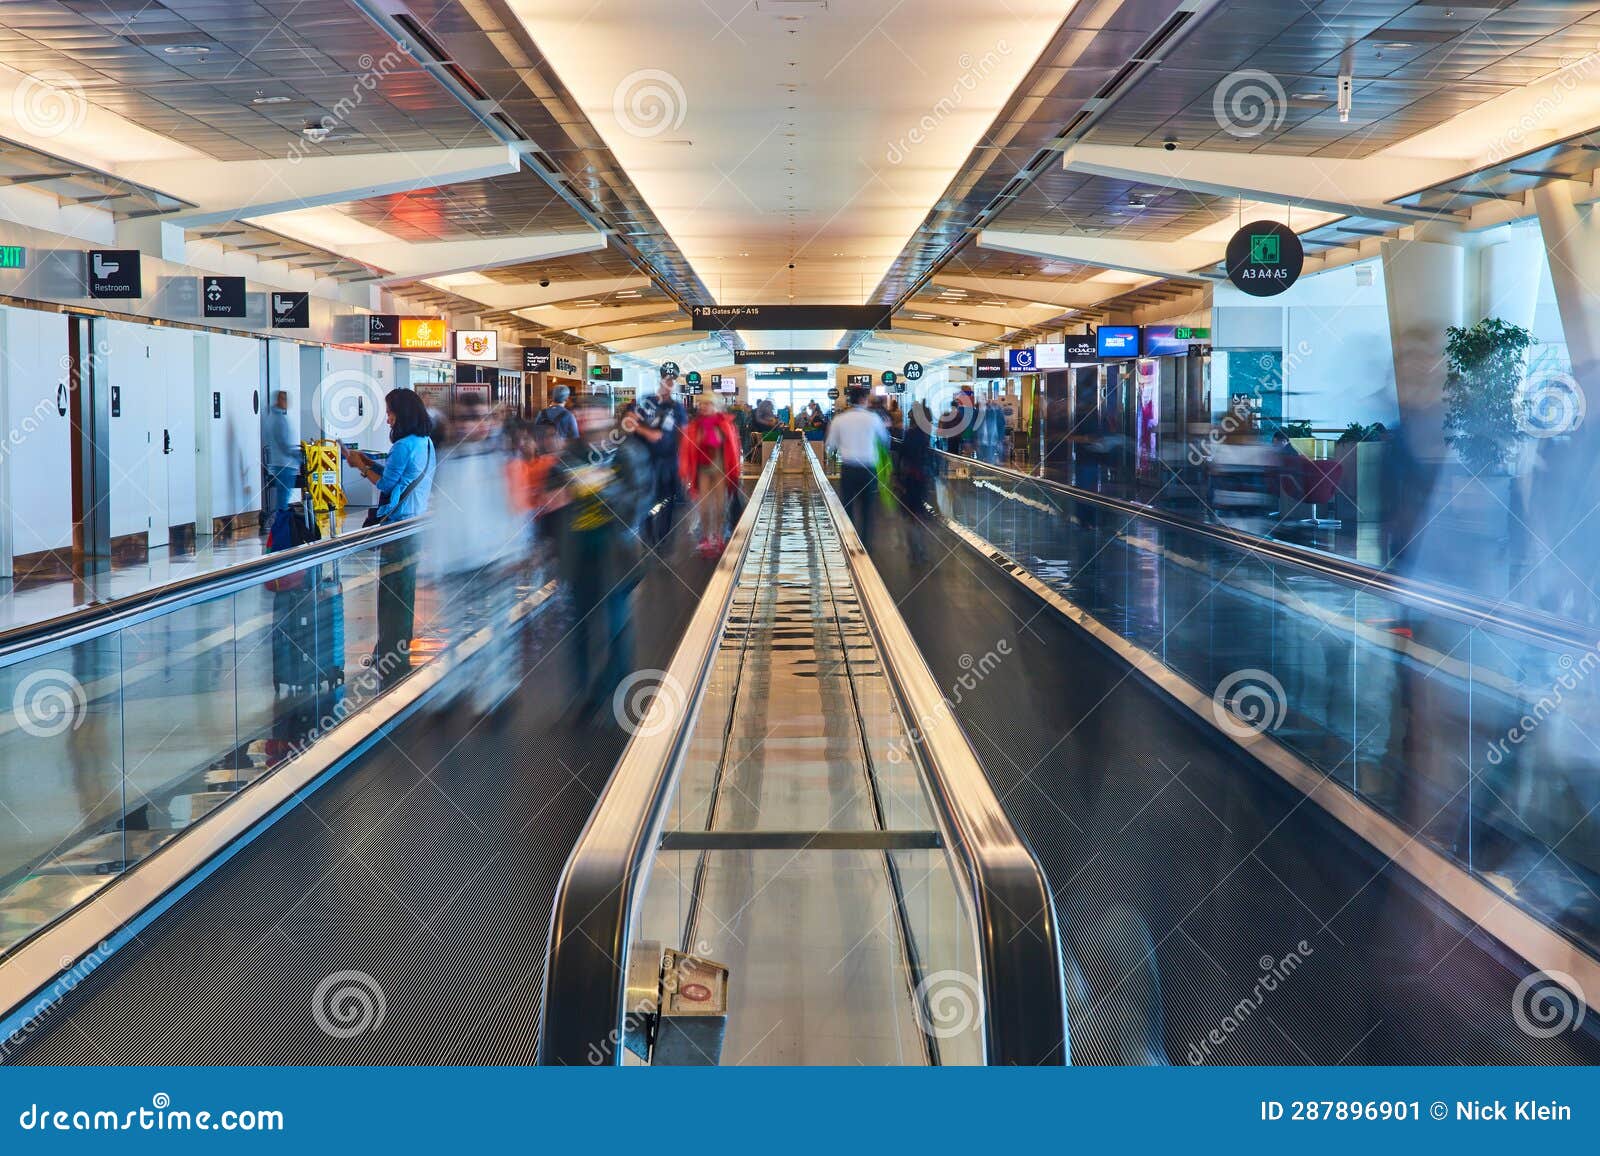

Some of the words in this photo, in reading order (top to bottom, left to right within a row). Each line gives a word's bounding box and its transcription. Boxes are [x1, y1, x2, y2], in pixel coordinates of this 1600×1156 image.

[1242, 269, 1256, 279] A3
[1258, 269, 1272, 279] A4
[1274, 269, 1288, 279] A5
[94, 283, 130, 292] Restroom
[207, 304, 231, 313] Nursery
[406, 338, 442, 347] Emirates
